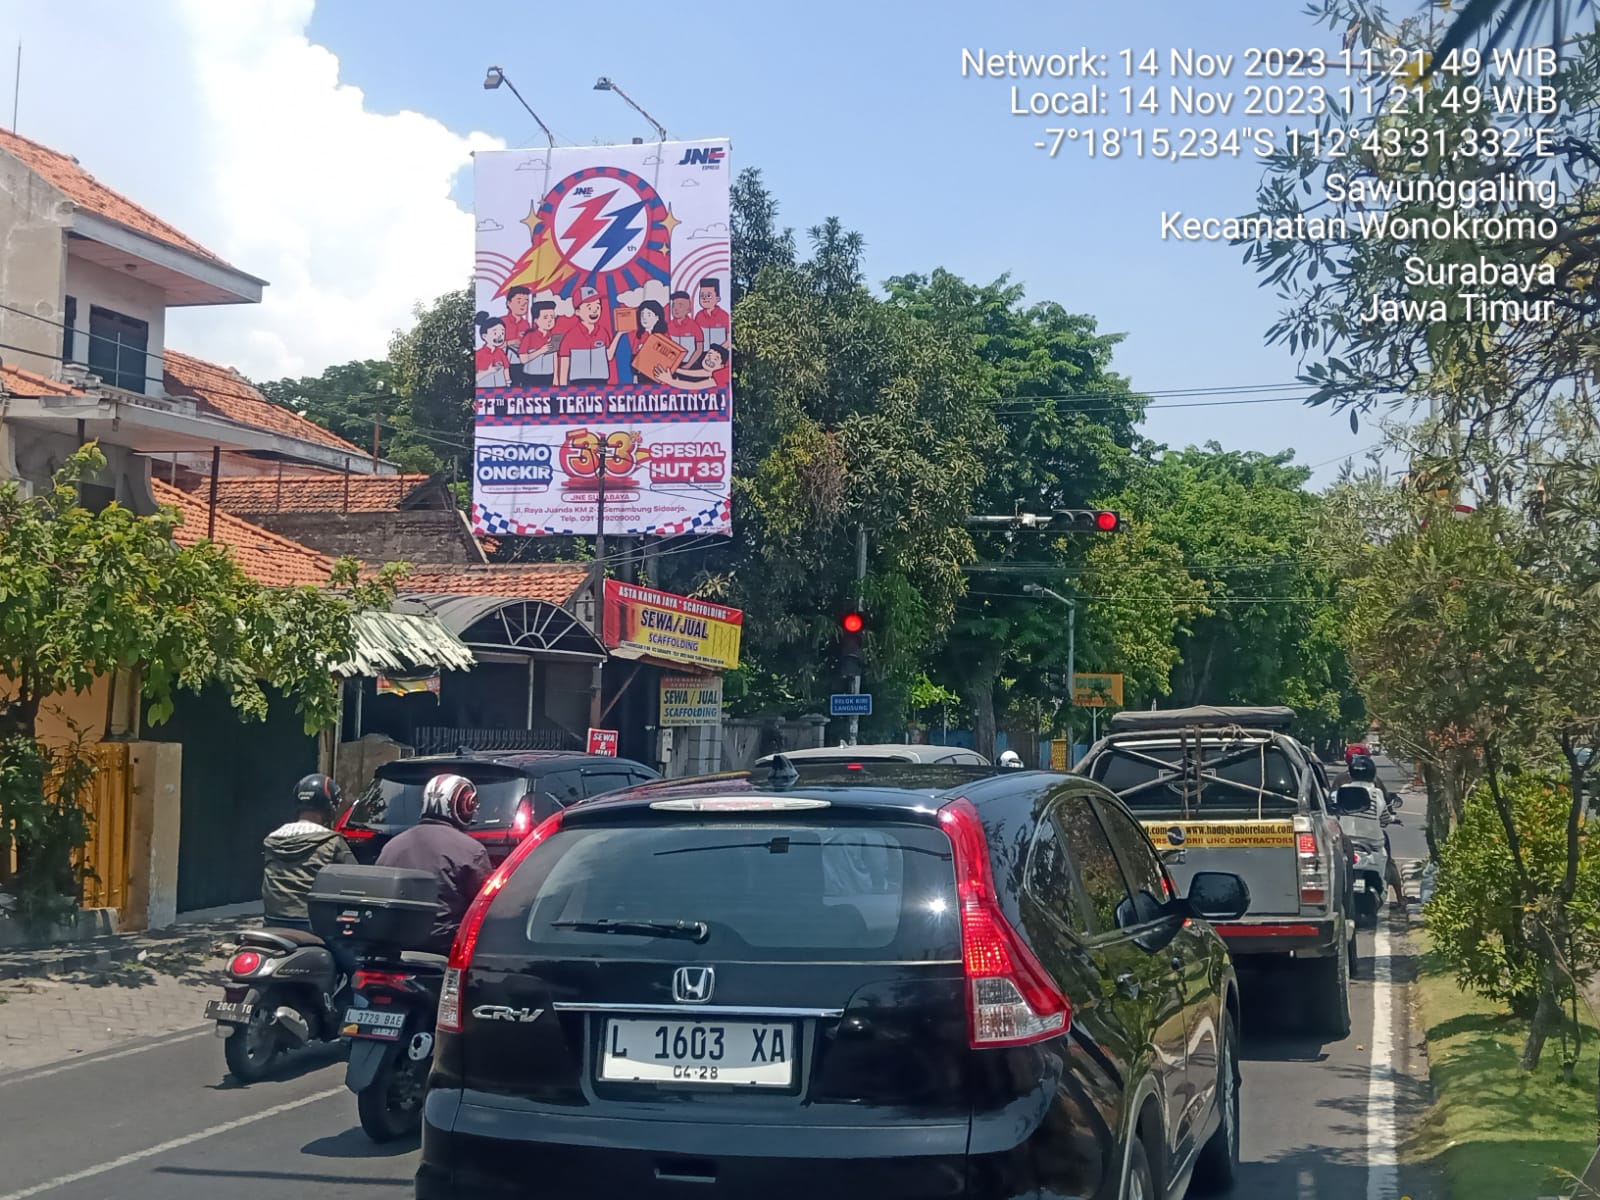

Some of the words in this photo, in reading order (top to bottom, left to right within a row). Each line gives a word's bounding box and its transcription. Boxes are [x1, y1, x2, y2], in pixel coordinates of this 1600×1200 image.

[677, 147, 725, 165] JNE
[507, 396, 551, 415] GASSS
[556, 395, 603, 414] TERUS
[479, 446, 550, 462] PROMO
[650, 443, 725, 458] SPESIAL
[479, 465, 551, 481] ONGKIR
[651, 462, 692, 477] HUT
[696, 462, 723, 477] 33
[649, 633, 699, 651] SCAFFOLDING
[663, 690, 688, 705] SEWA
[697, 690, 718, 705] JUAL
[664, 707, 717, 718] SCAFFOLDING
[593, 732, 615, 742] SEWA
[471, 1004, 545, 1023] CR-V
[611, 1025, 627, 1058] L
[654, 1026, 726, 1061] 1603
[750, 1028, 787, 1063] XA
